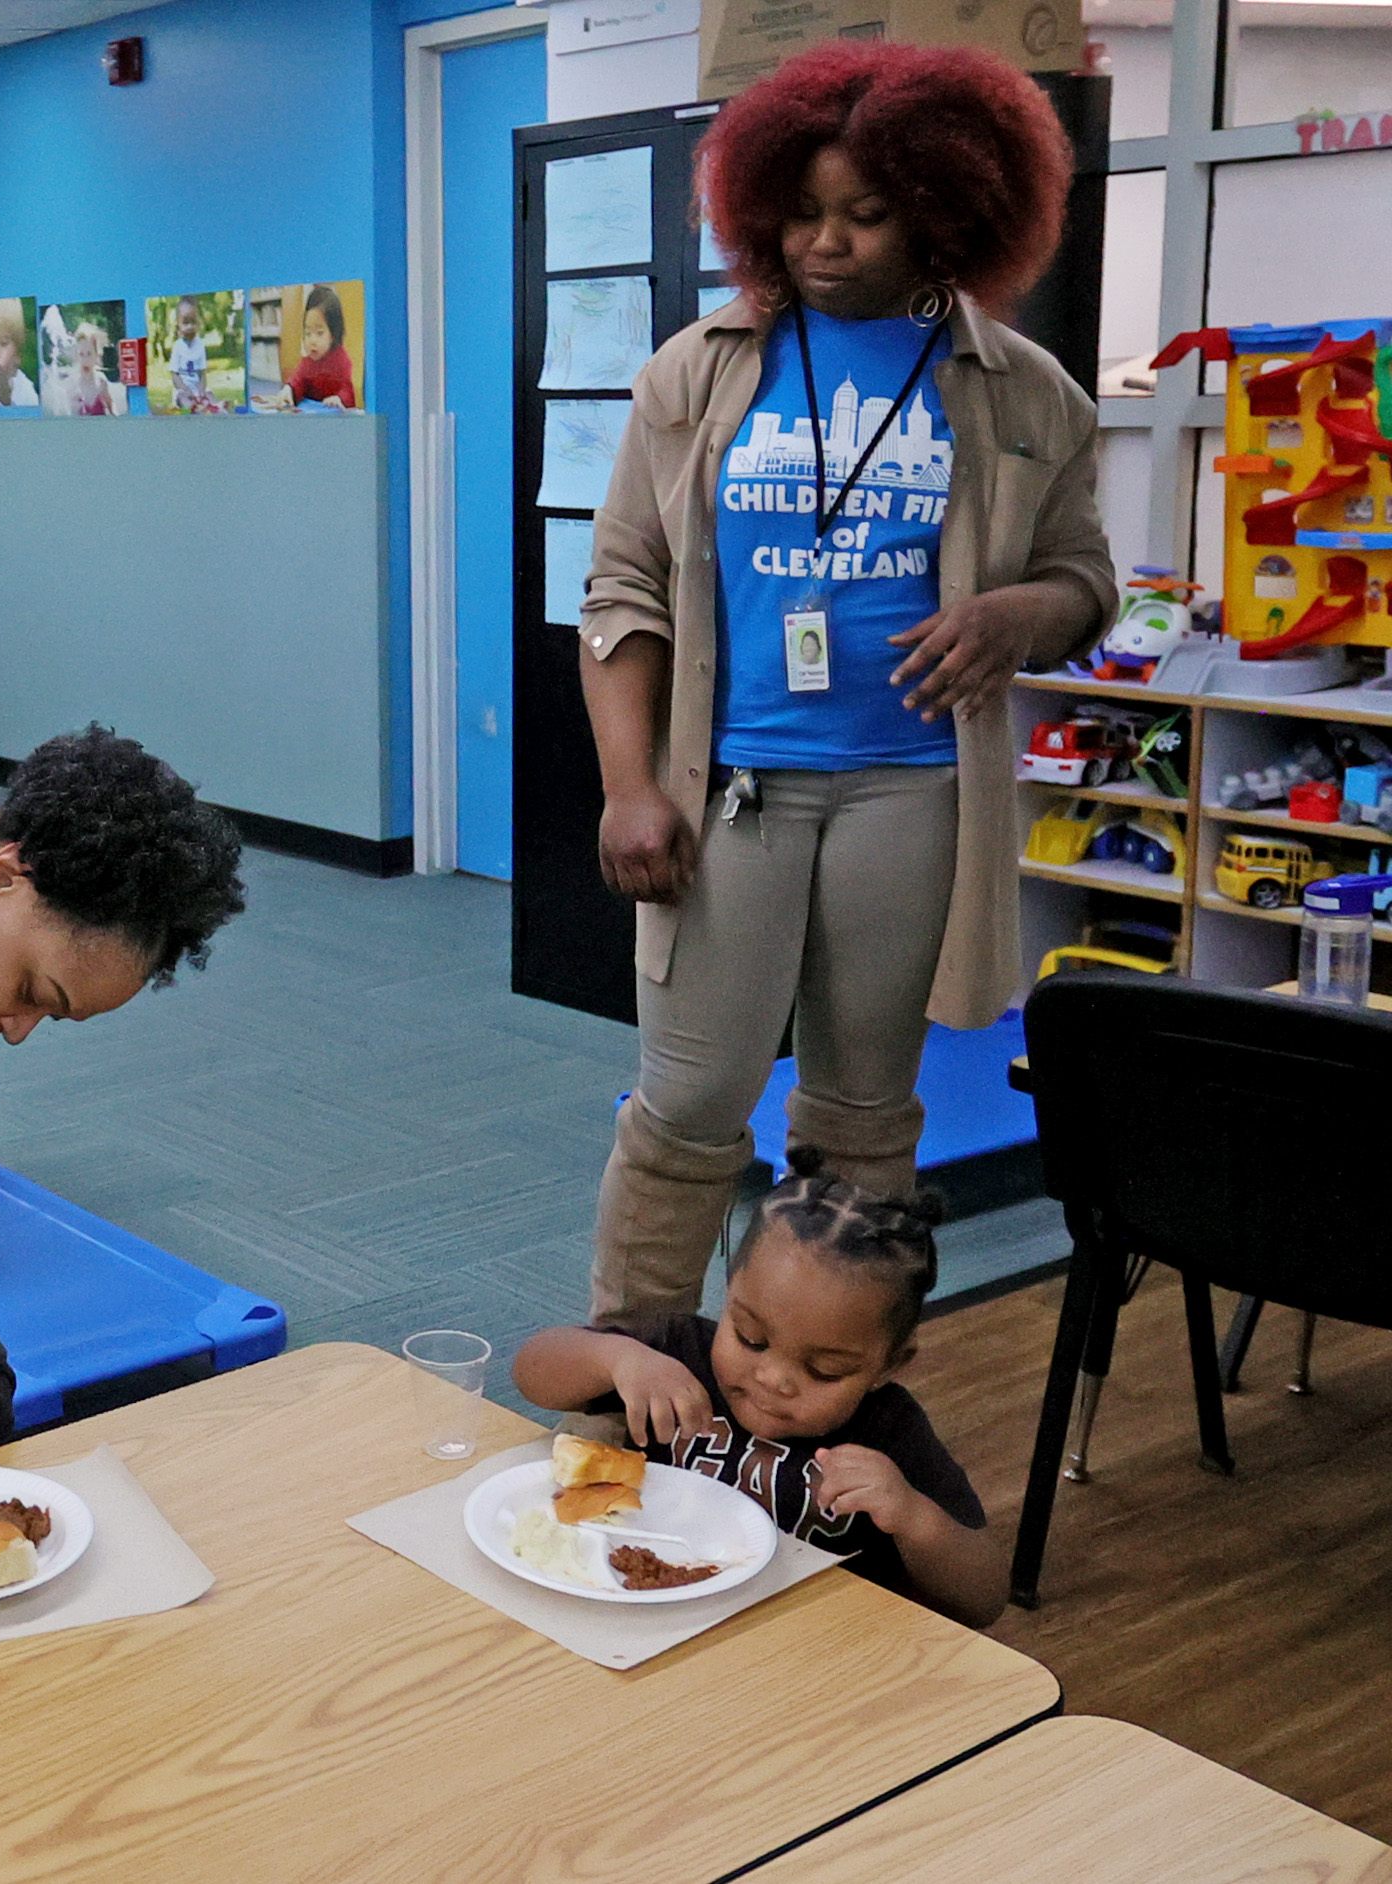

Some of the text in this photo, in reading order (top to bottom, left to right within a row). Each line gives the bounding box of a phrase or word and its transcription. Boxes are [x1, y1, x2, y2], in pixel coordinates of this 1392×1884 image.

[723, 483, 893, 519] CHILDREN
[832, 522, 870, 549] of
[752, 546, 928, 580] CLEVELAND
